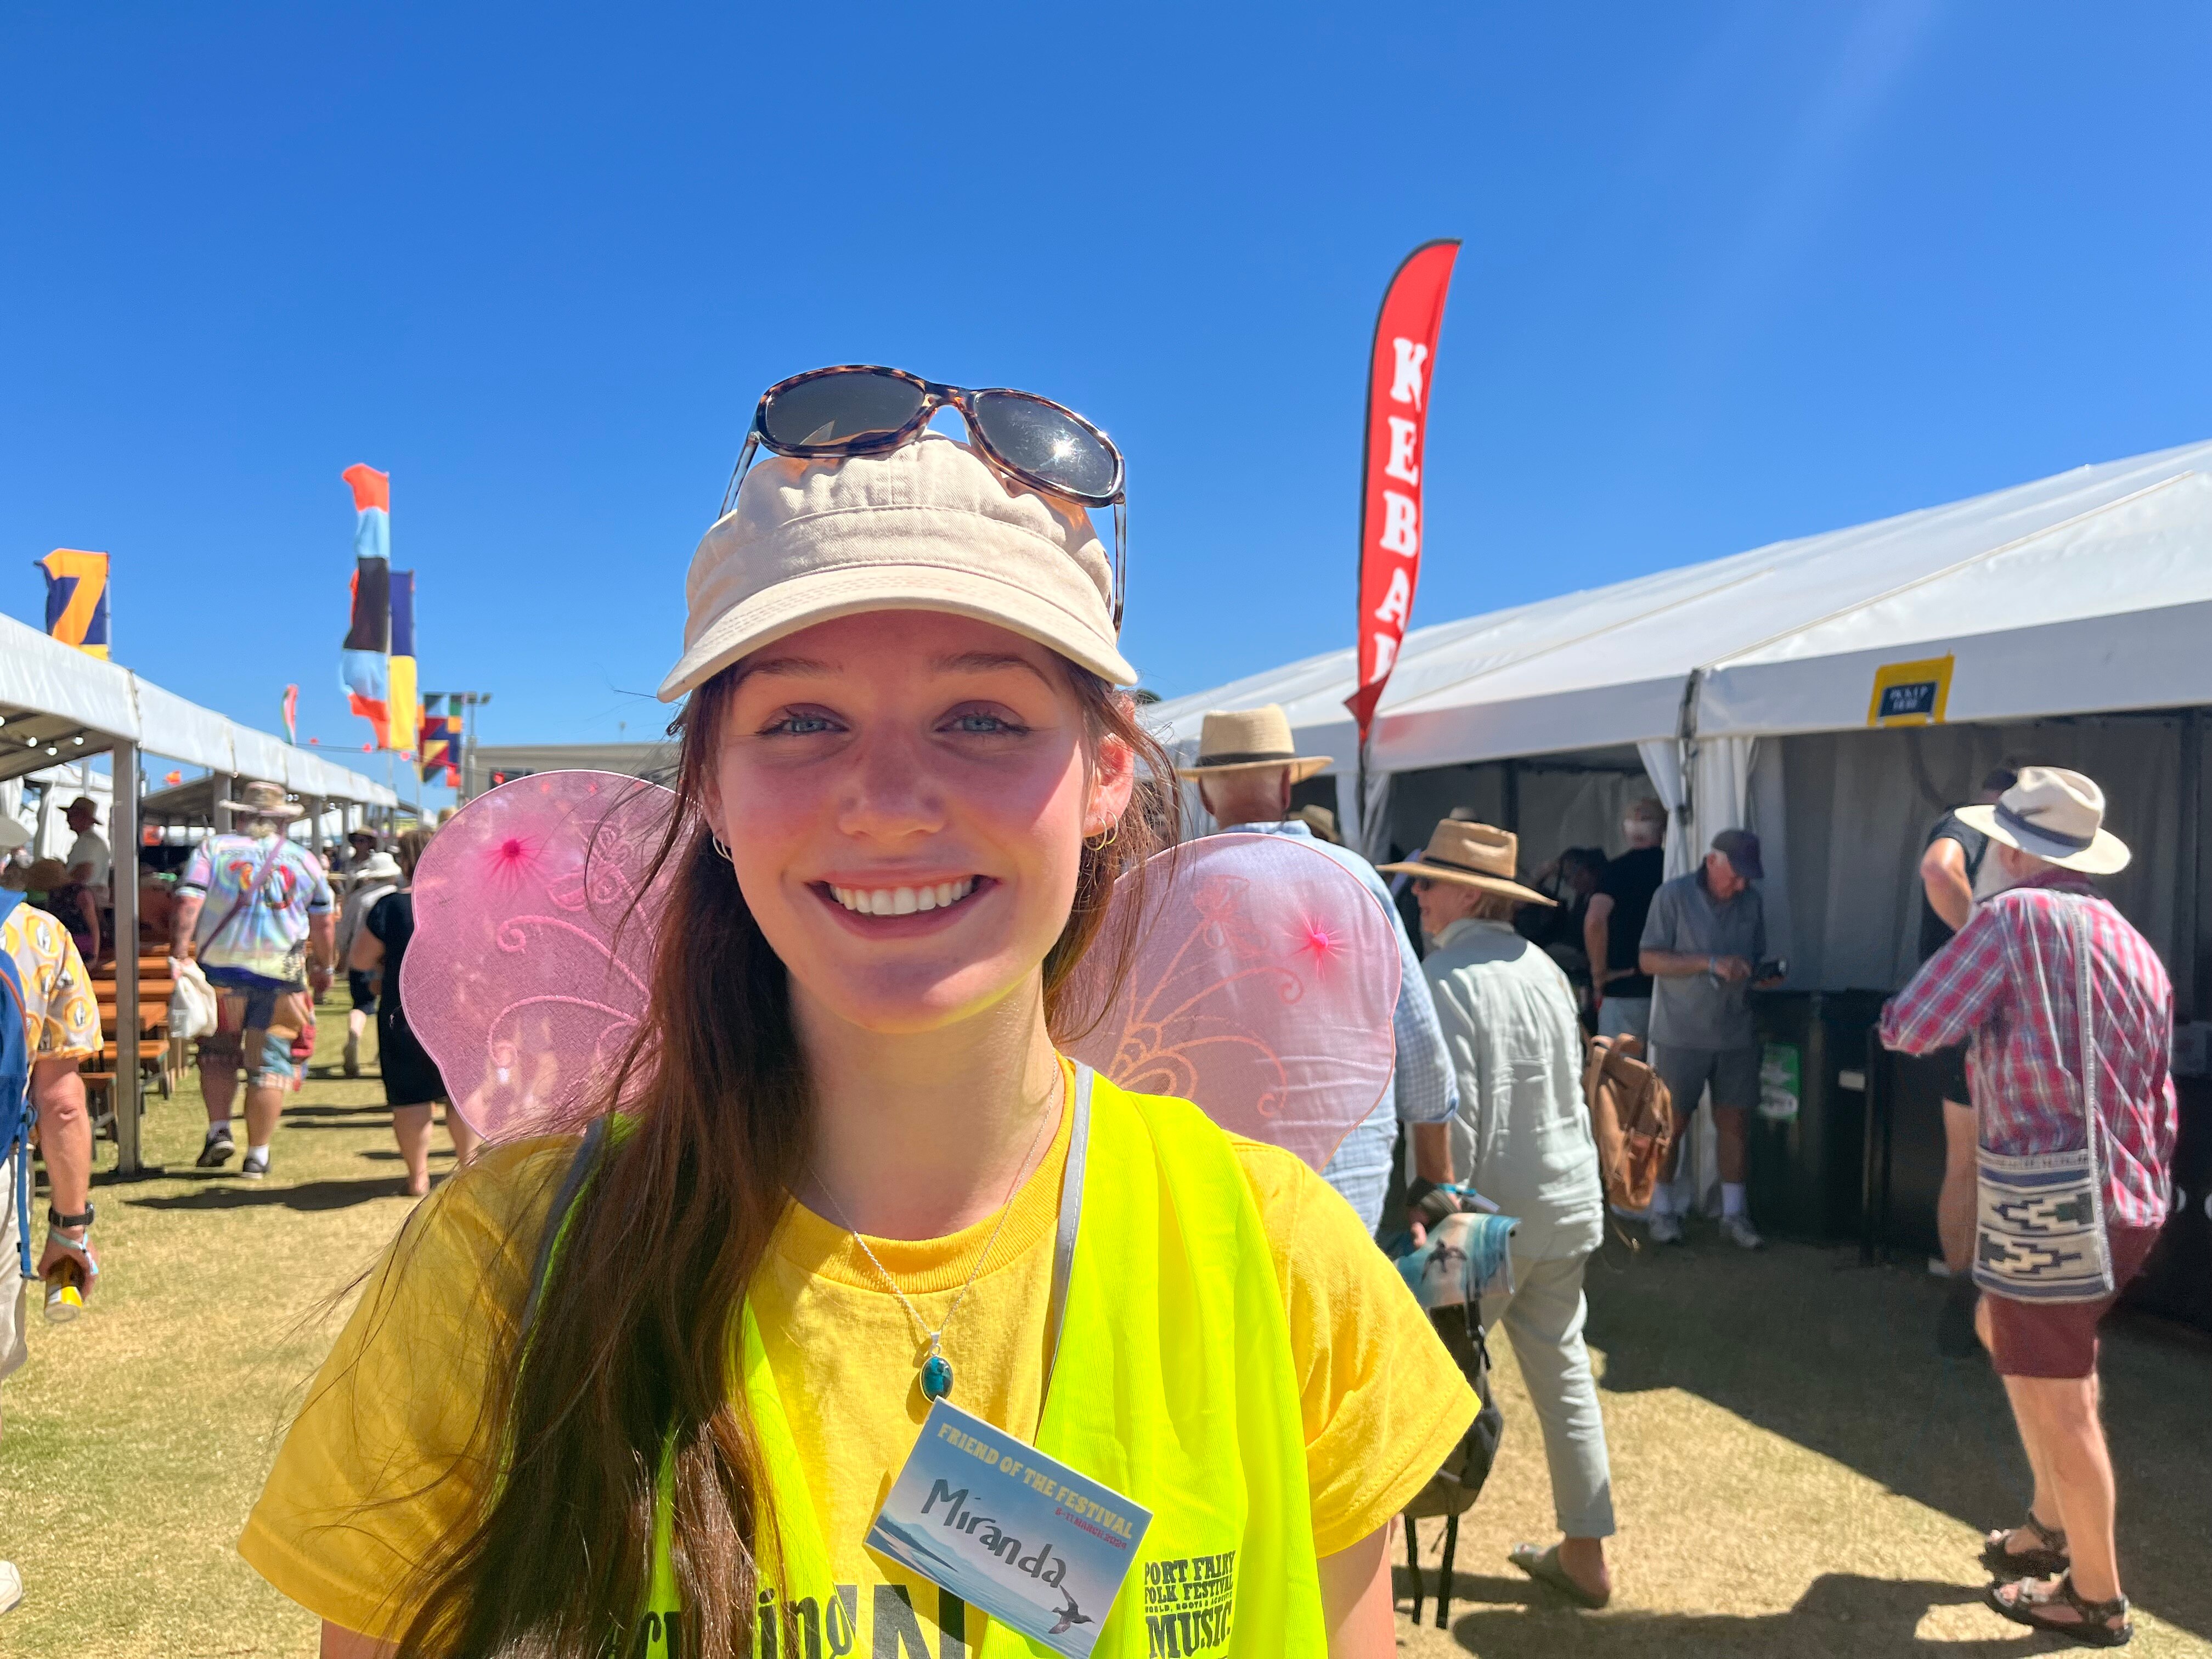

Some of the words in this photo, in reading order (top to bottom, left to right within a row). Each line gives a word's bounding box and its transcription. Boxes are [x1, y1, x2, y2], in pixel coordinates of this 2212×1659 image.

[937, 1423, 1000, 1465] FRIEND
[999, 1456, 1024, 1477] OF
[1023, 1467, 1058, 1498] THE
[1054, 1486, 1133, 1539] FESTIVAL
[921, 1479, 1066, 1588] Miranda
[1074, 1517, 1104, 1539] MARCH
[1144, 1559, 1188, 1585] PORT
[1192, 1550, 1236, 1581] FAIRY
[1144, 1585, 1178, 1605] FOLK
[1183, 1573, 1234, 1600] FESTIVAL
[1176, 1600, 1203, 1611] ROOTS
[1146, 1600, 1232, 1658] MUSIC
